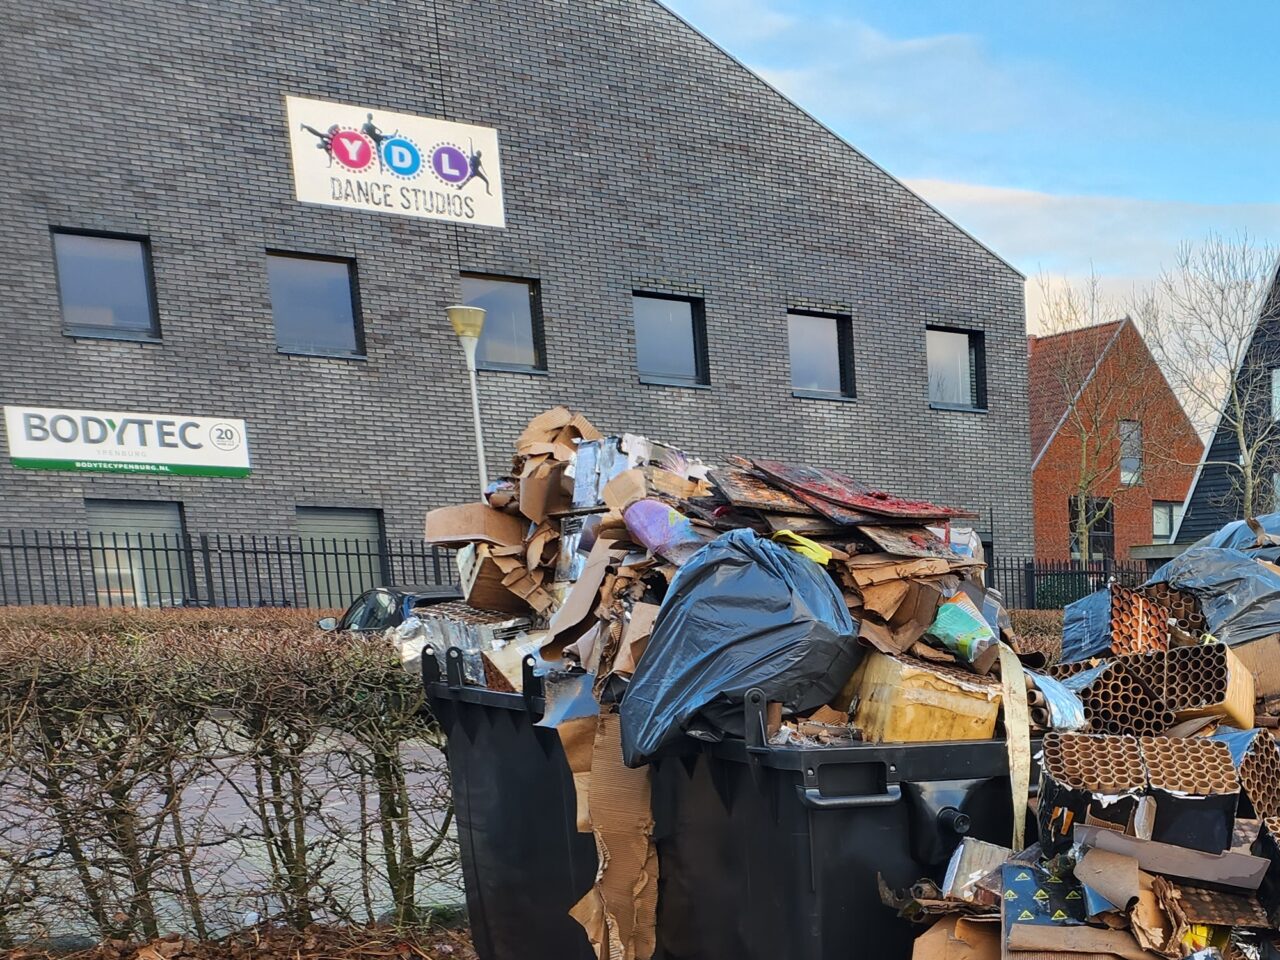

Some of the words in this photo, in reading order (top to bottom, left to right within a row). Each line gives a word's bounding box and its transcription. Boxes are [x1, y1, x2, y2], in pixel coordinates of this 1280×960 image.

[331, 177, 394, 208] DANCE
[400, 186, 475, 219] STUDIOS
[22, 412, 204, 450] BODYTEC
[215, 428, 234, 440] 20
